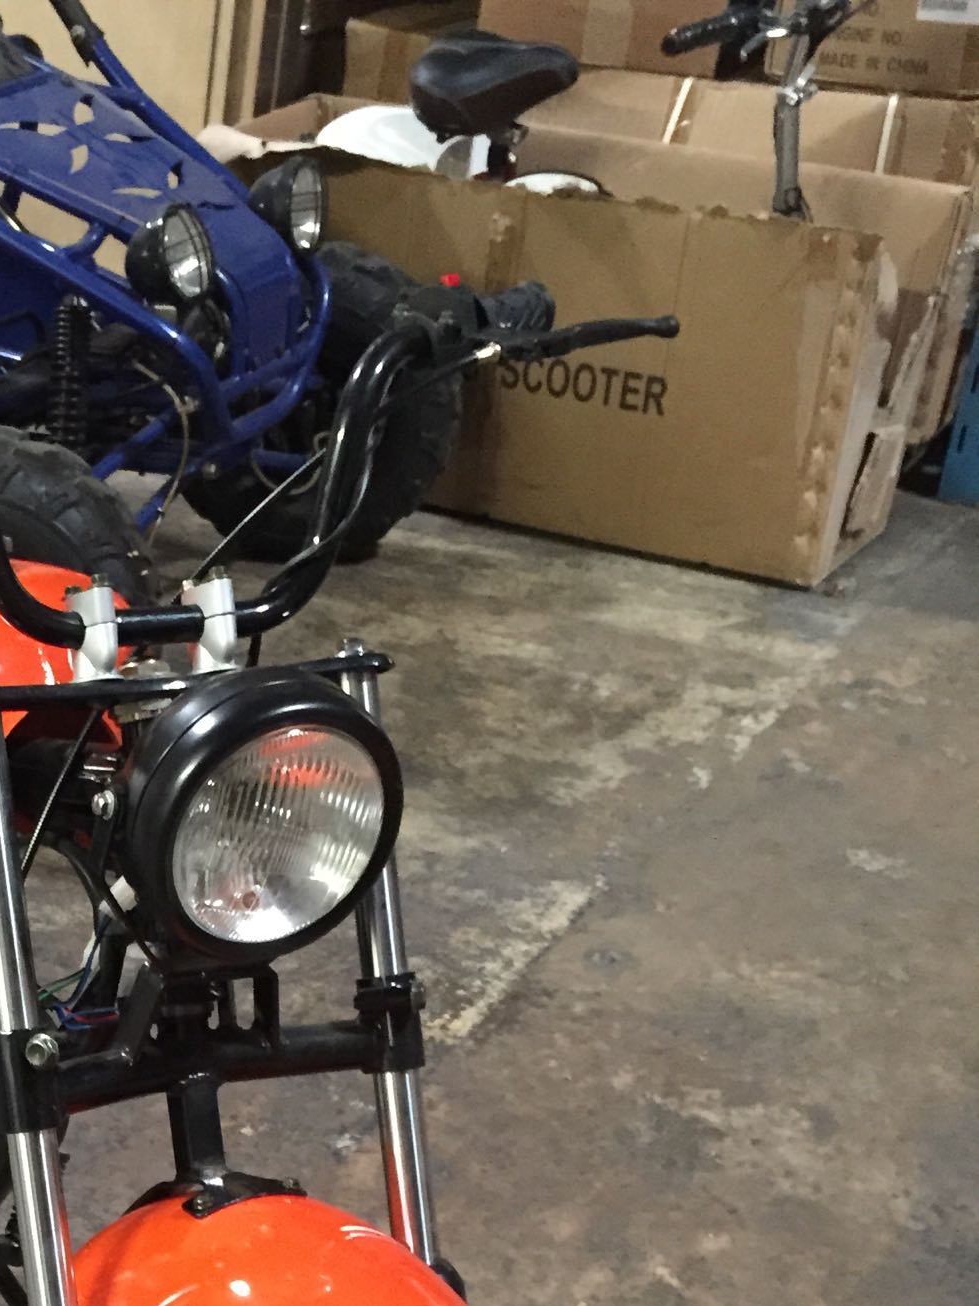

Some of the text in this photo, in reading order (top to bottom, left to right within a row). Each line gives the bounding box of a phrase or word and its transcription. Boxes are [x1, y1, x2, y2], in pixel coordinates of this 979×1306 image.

[820, 51, 857, 69] MADE
[887, 57, 928, 74] CHINA
[497, 358, 668, 416] SCOOTER
